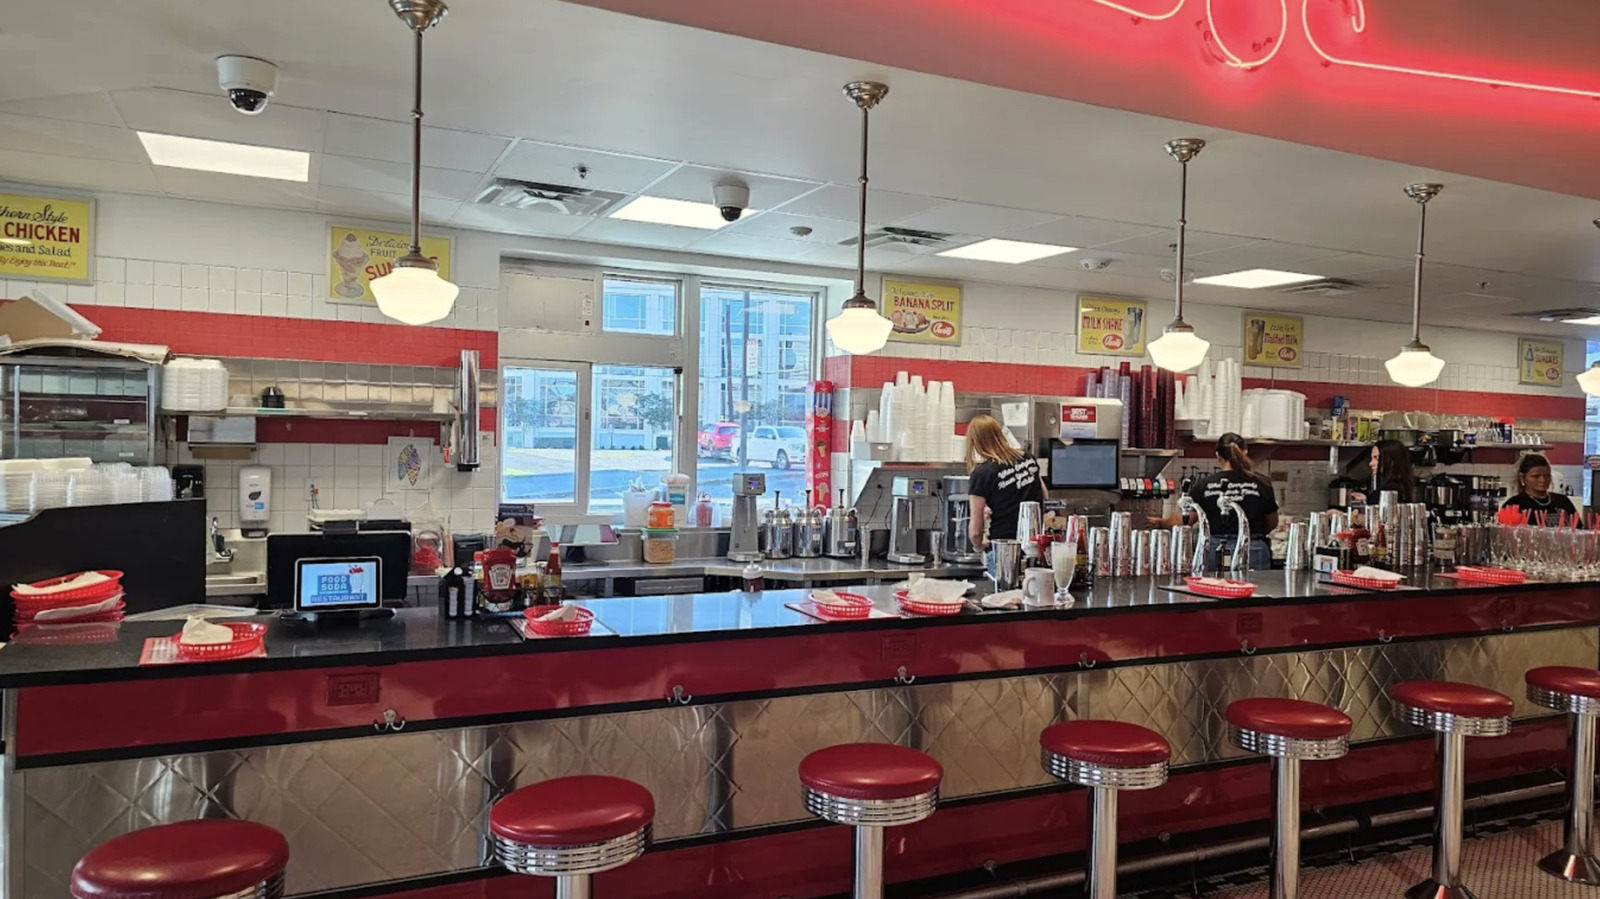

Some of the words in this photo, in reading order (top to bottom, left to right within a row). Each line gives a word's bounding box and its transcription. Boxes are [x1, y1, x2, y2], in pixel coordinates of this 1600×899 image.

[31, 204, 68, 224] Style
[4, 221, 80, 243] CHICKEN
[15, 245, 35, 254] and
[38, 245, 72, 257] Salad
[370, 248, 397, 258] FRUIT
[894, 296, 930, 309] BANANA
[931, 299, 955, 312] SPLIT
[1082, 315, 1101, 330] MILK
[1102, 317, 1124, 332] SHAKE
[321, 576, 347, 584] FOOD
[321, 583, 347, 591] SODA
[311, 594, 364, 603] RESTAURANT
